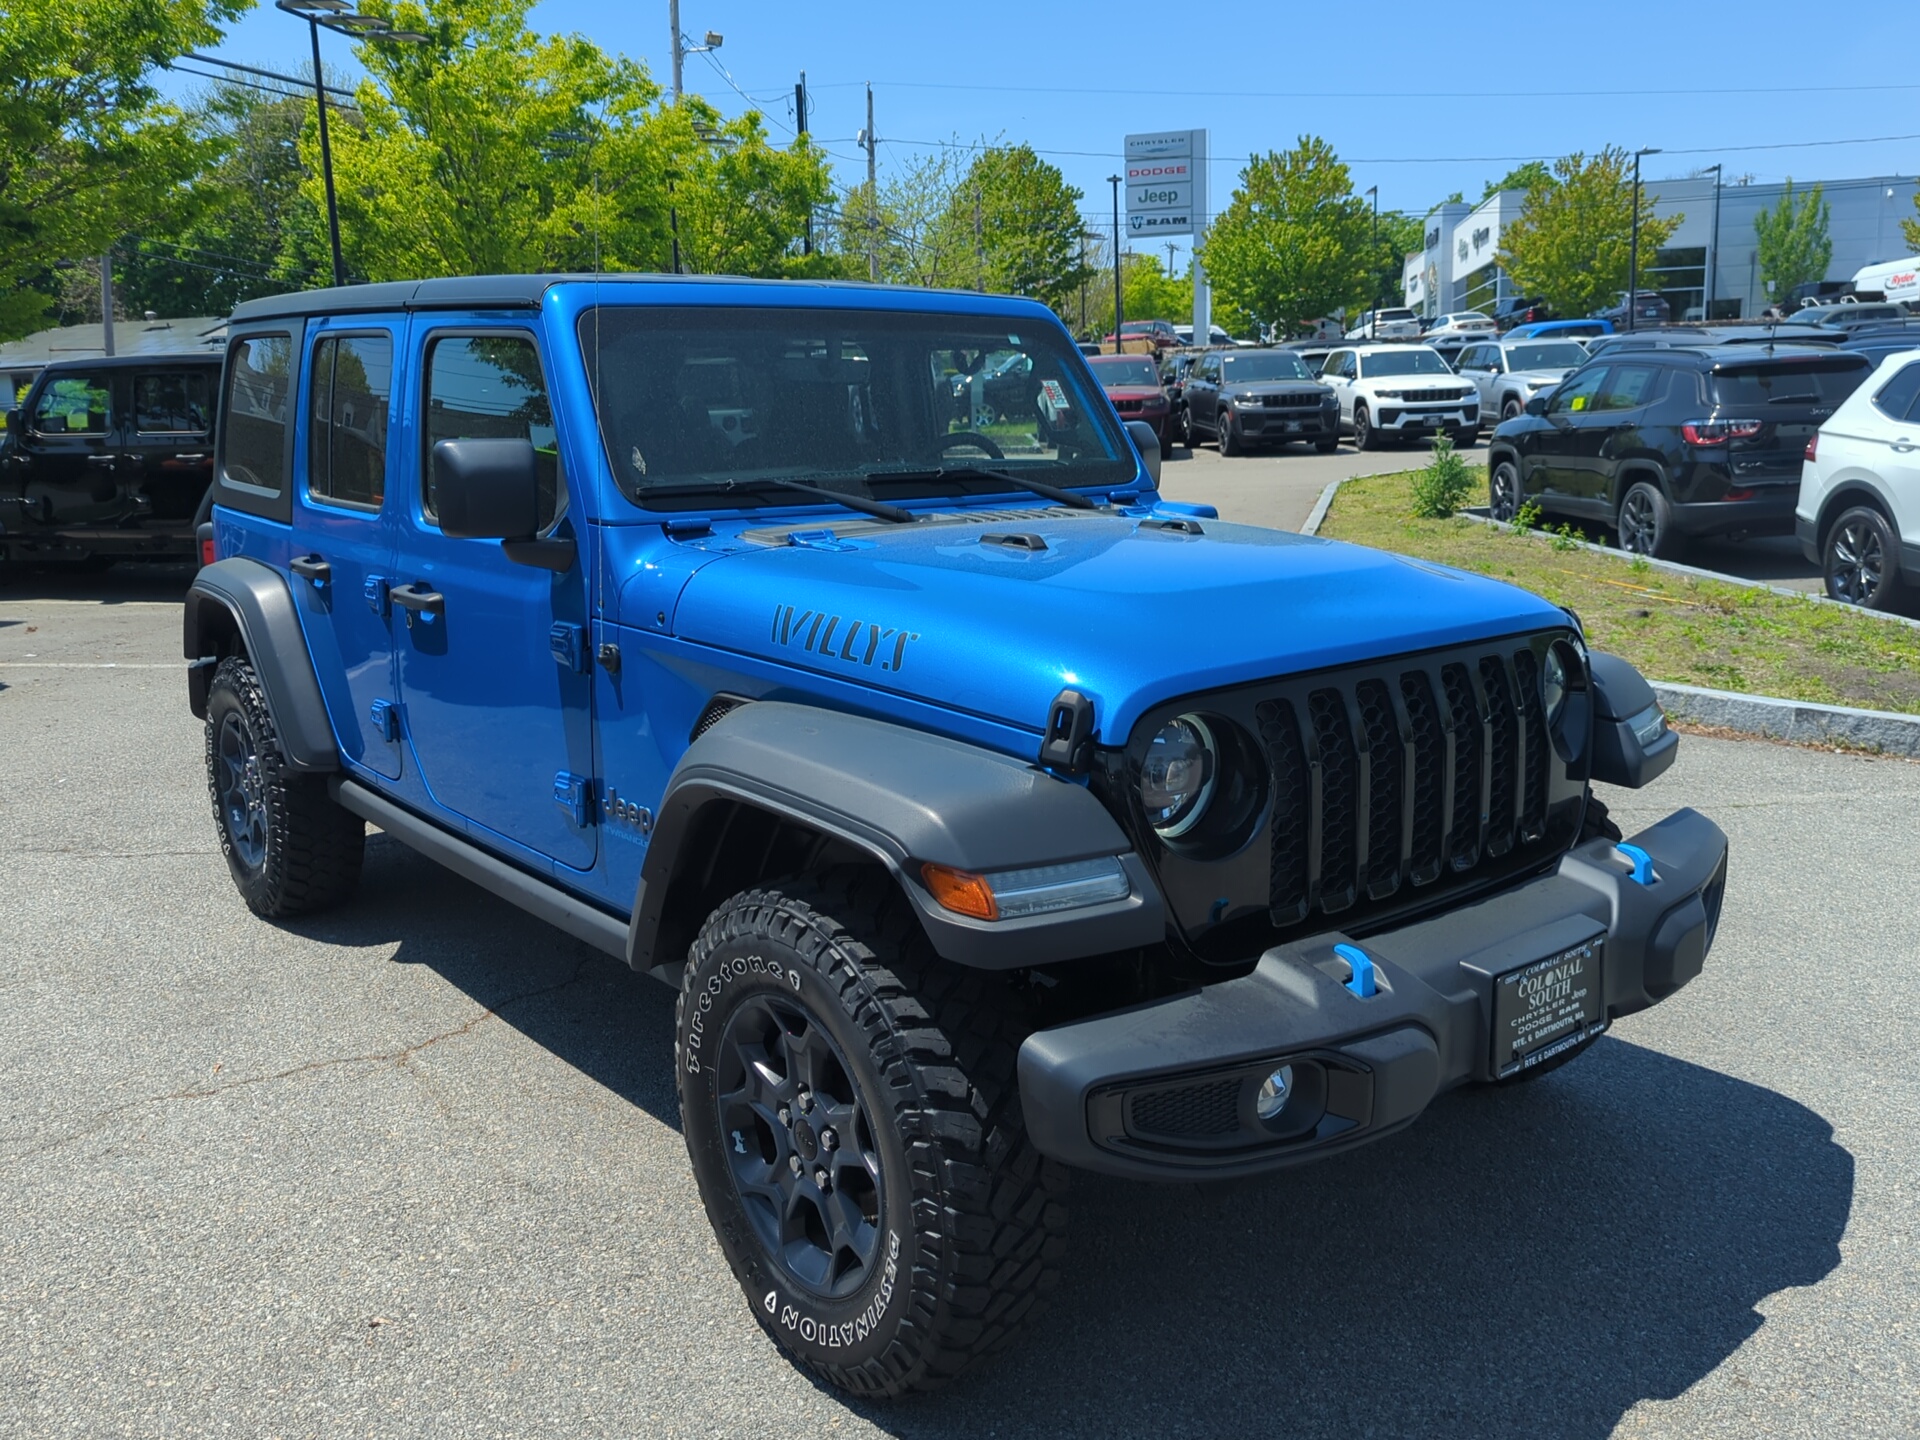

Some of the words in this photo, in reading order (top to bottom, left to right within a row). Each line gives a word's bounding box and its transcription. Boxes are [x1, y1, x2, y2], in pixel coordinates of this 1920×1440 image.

[1130, 137, 1184, 147] CHRYSLER
[1128, 166, 1186, 178] DODGE
[1137, 188, 1178, 205] Jeep
[1146, 216, 1188, 226] RAM
[1892, 273, 1916, 286] Ryder
[602, 786, 654, 835] Jeep
[1518, 958, 1584, 998] COLONIAL
[1510, 998, 1566, 1028] CHRYSLER
[1571, 988, 1588, 1001] Jeep
[1528, 979, 1572, 1011] SOUTH
[685, 955, 785, 1074] Firestone
[1512, 1036, 1528, 1050] RTE.
[1575, 1010, 1585, 1022] MA
[1518, 1013, 1553, 1035] DODGE
[1558, 1001, 1580, 1017] RAM
[1524, 1056, 1538, 1069] RTE.
[781, 1229, 901, 1347] DESTINATION
